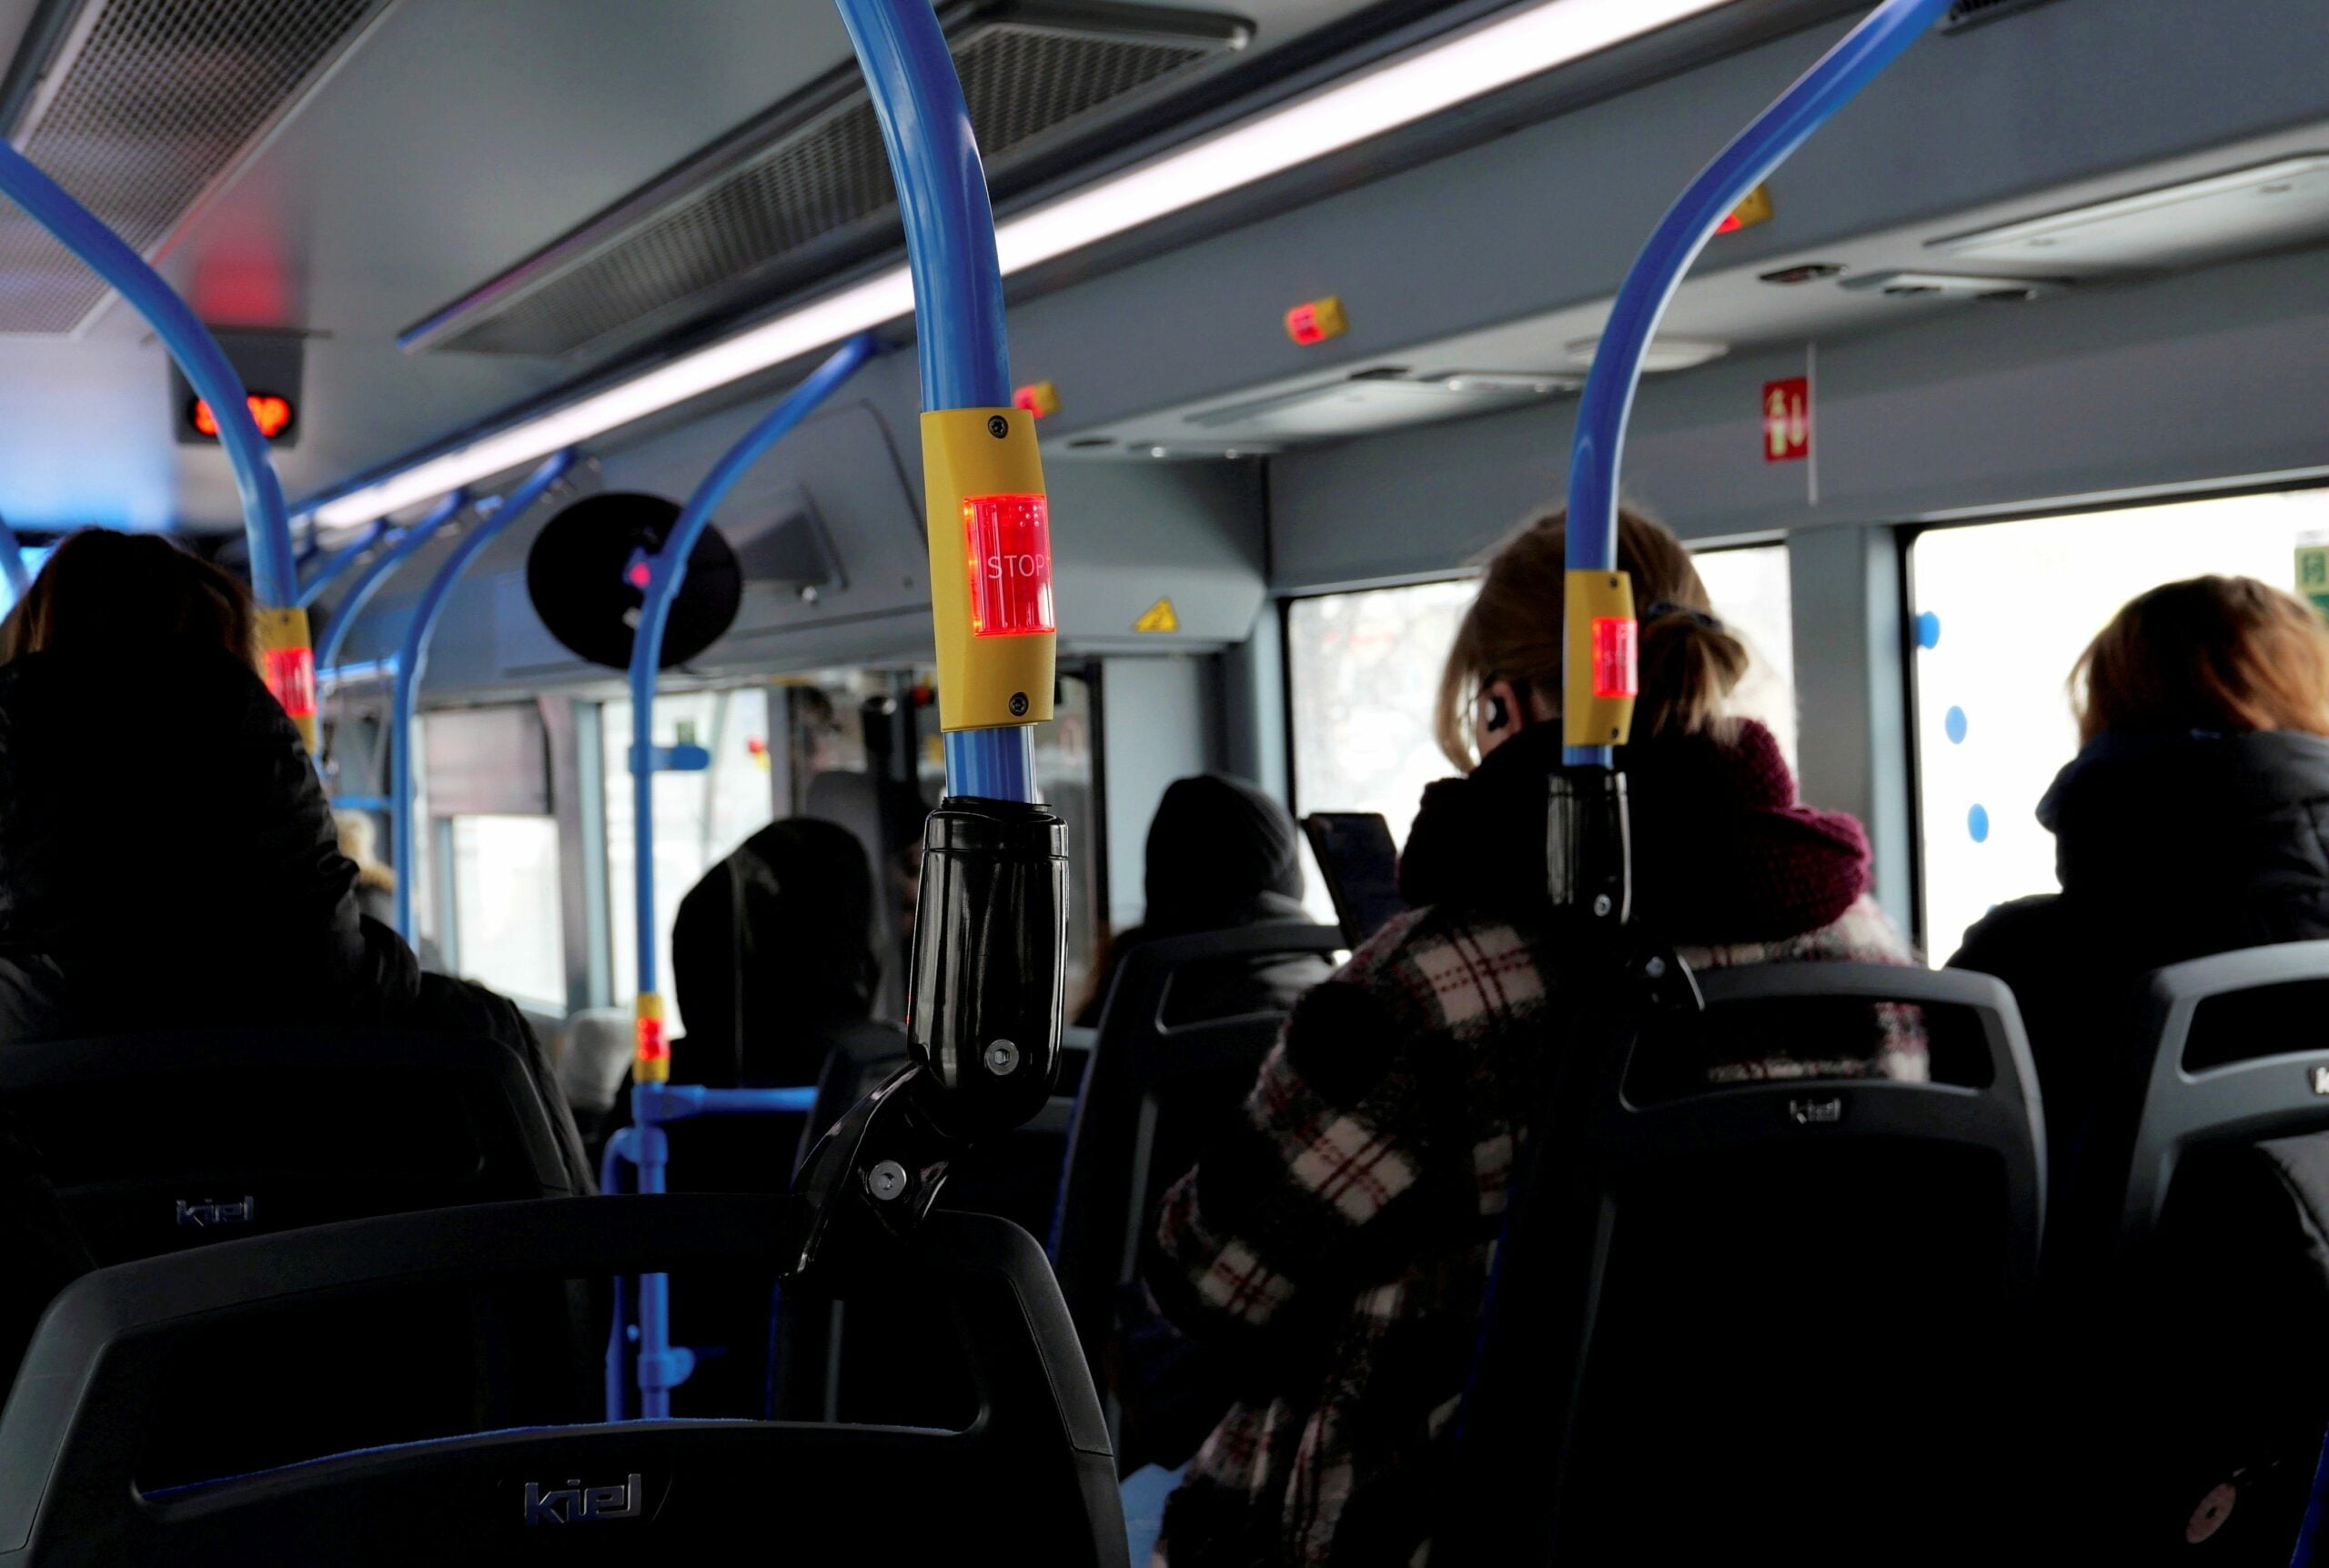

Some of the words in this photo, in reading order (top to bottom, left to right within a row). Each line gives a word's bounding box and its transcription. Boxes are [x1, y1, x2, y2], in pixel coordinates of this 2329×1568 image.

[987, 554, 1045, 578] STOP
[176, 1195, 255, 1227] kiel
[524, 1473, 642, 1525] kiel
